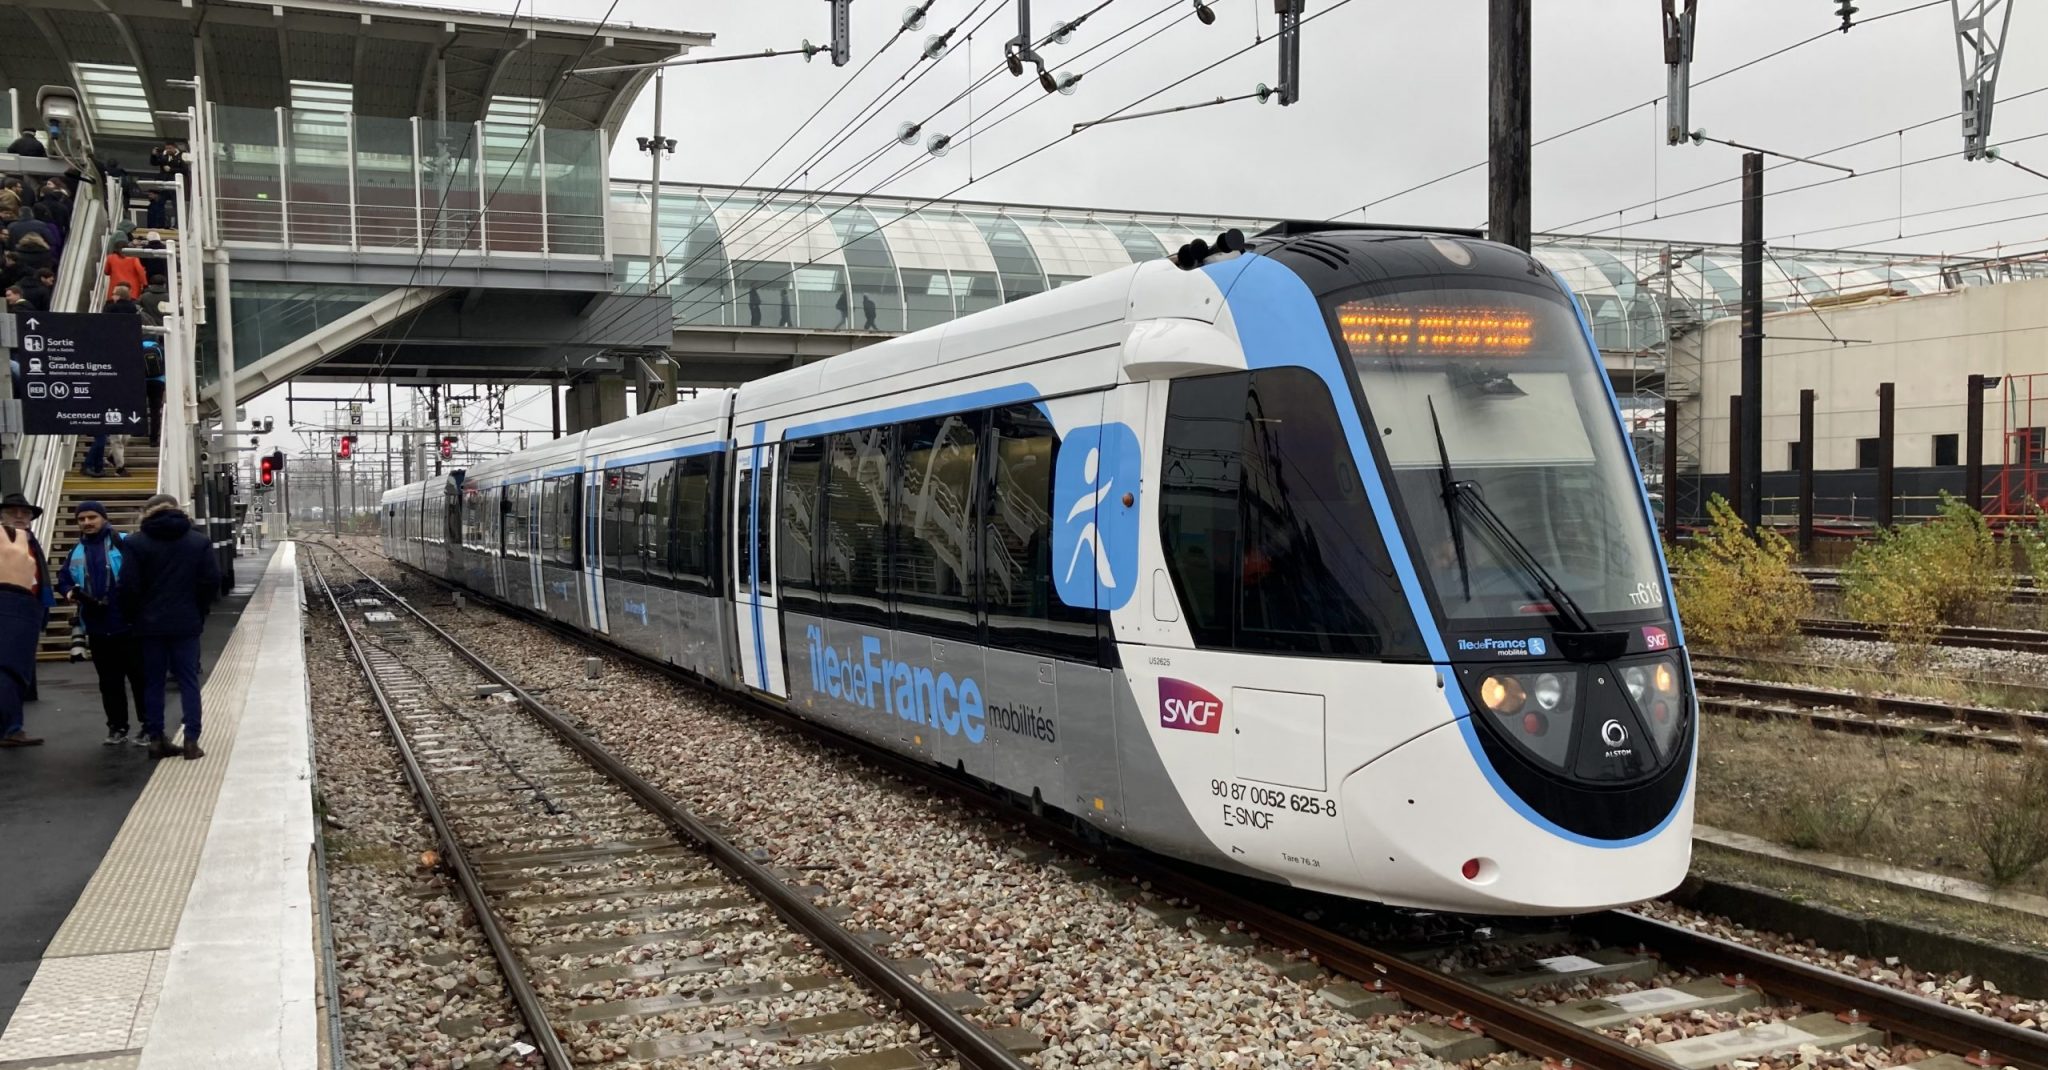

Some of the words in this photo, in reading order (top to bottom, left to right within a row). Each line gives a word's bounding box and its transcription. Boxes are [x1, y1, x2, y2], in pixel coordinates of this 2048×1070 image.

[47, 338, 74, 346] Sortie
[48, 362, 84, 370] Grandes
[86, 362, 112, 371] lignes
[30, 386, 44, 394] RER
[74, 386, 89, 394] BUS
[56, 411, 101, 419] Ascenseur
[1647, 633, 1666, 648] SNCF
[1162, 698, 1219, 726] SNCF
[989, 702, 1055, 743] mobilités
[1605, 749, 1632, 758] ALSTOM
[1211, 779, 1228, 797] 90
[1231, 783, 1247, 801] 87
[1251, 786, 1286, 809] 0052
[1290, 794, 1337, 817] 625-8
[1223, 804, 1274, 829] F-SNCF
[1281, 852, 1300, 864] Tare
